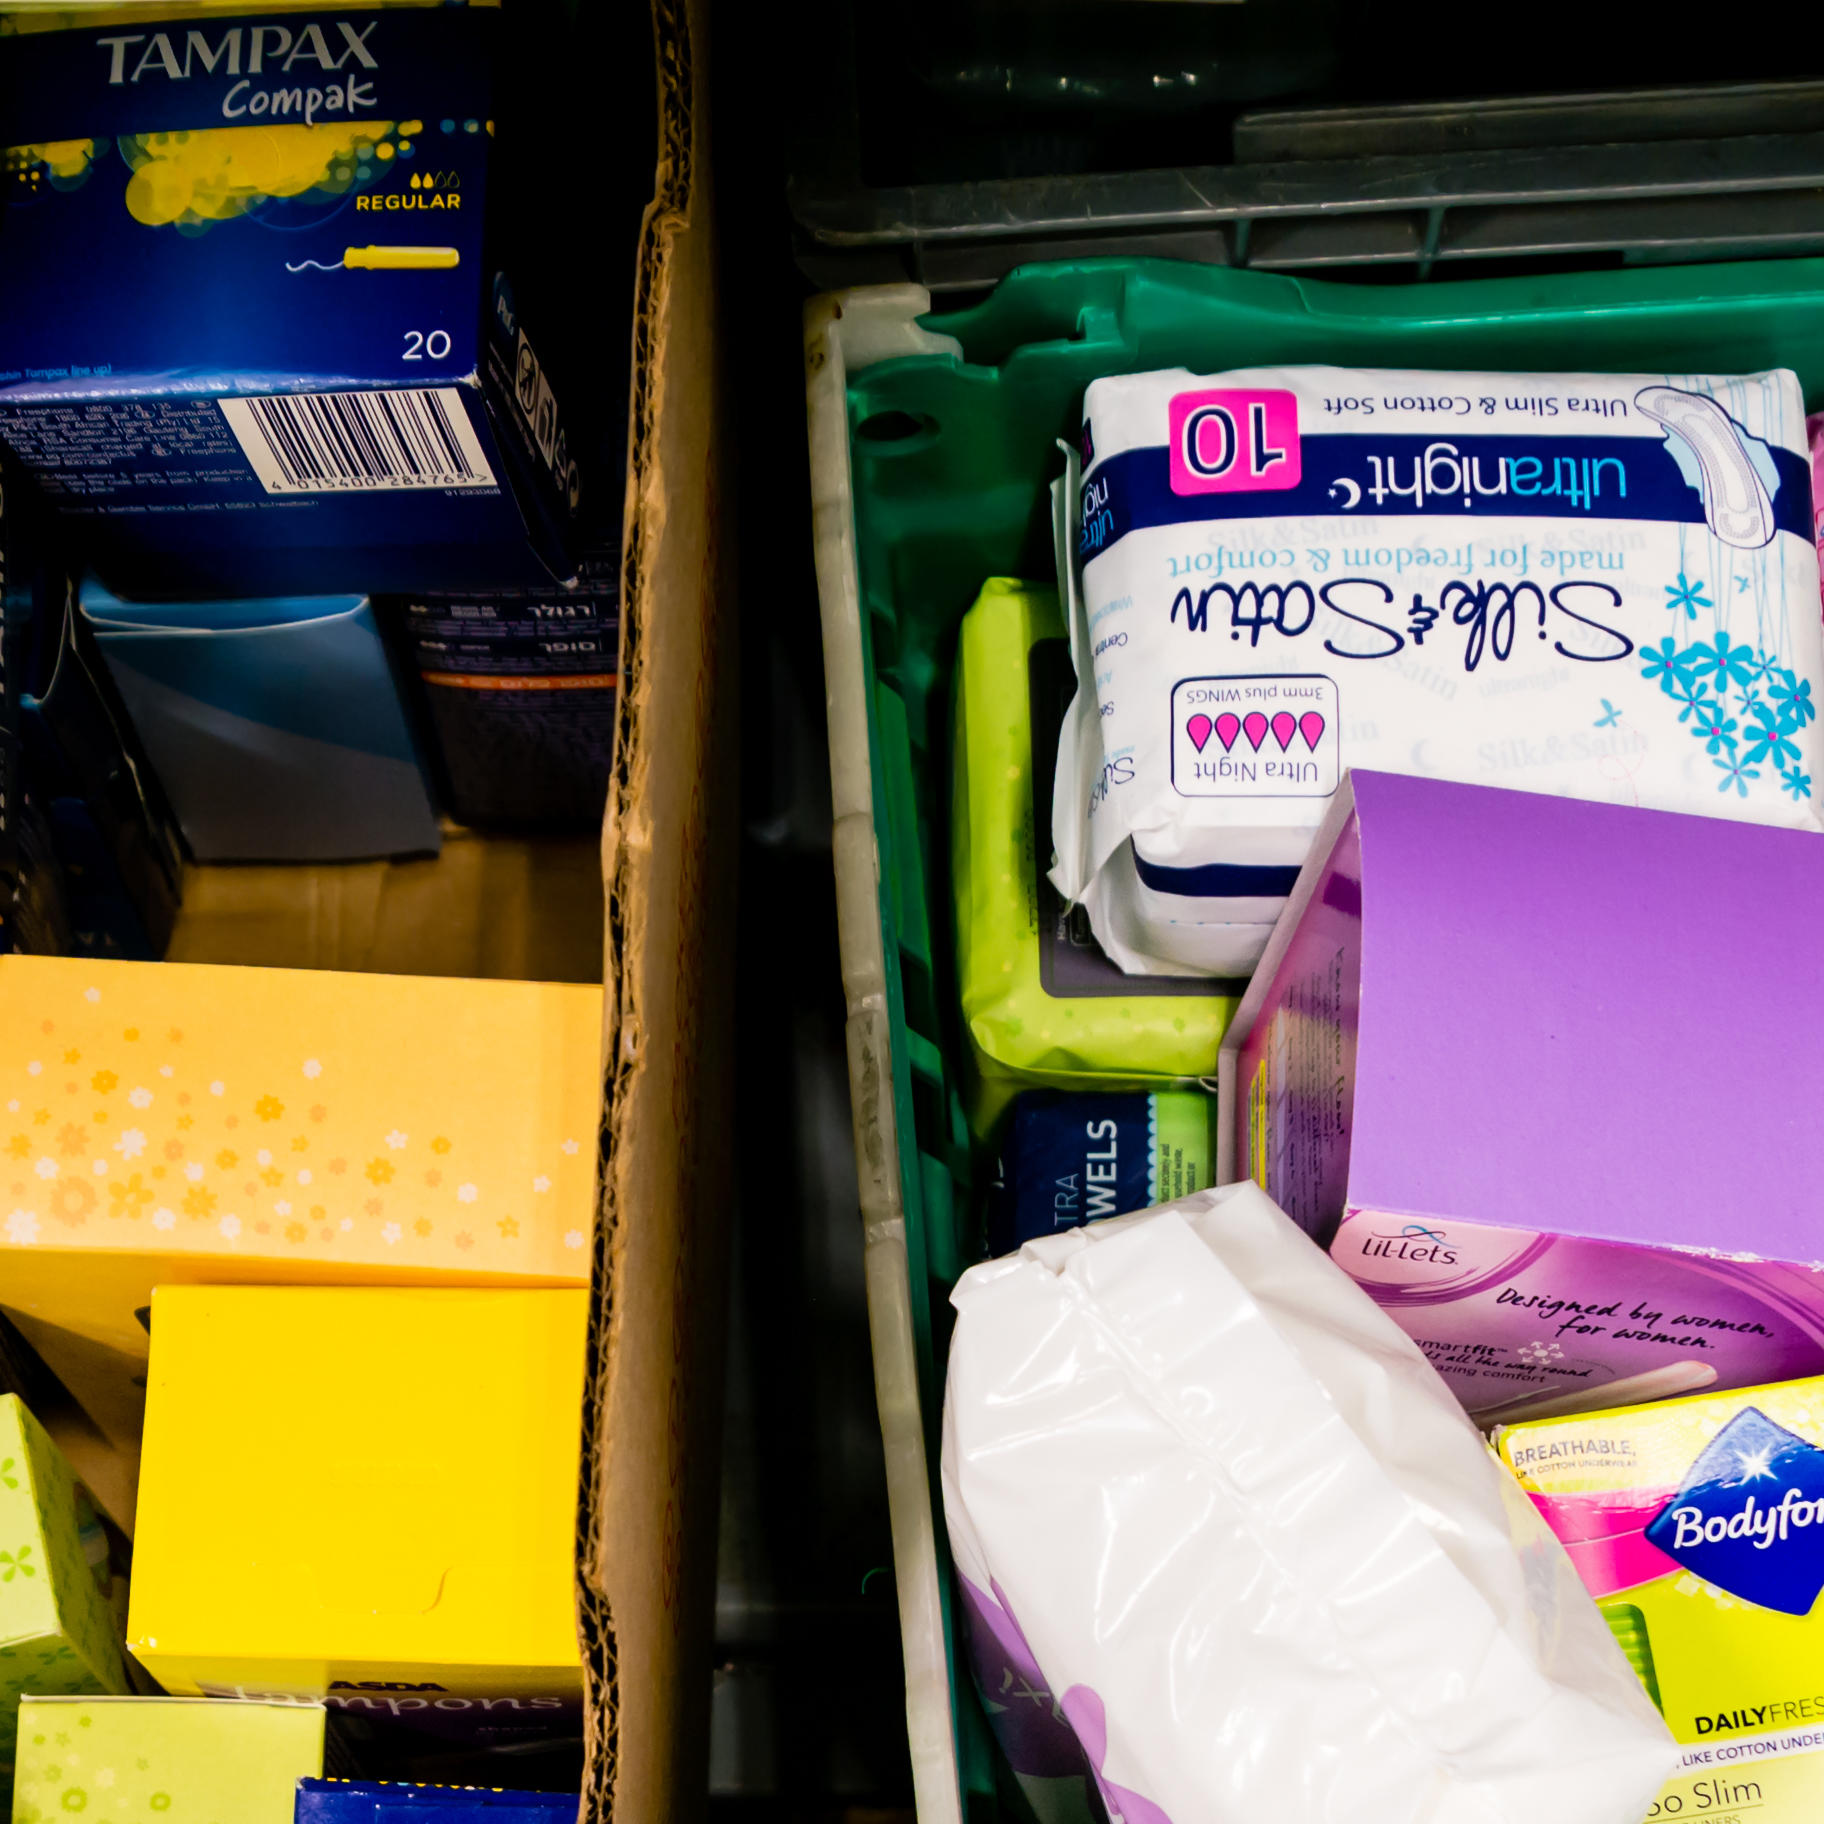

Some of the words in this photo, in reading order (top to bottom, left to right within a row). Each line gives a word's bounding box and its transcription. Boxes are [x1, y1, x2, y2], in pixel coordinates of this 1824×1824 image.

[97, 21, 379, 85] TAMPAX
[222, 75, 377, 125] Compak
[356, 194, 460, 211] REGULAR
[402, 329, 451, 361] 20
[1323, 396, 1376, 417] Soft
[1382, 397, 1471, 419] Cotton
[1478, 398, 1497, 418] &
[1505, 397, 1558, 418] Slim
[1568, 397, 1628, 418] Ultra
[1185, 401, 1288, 477] 10
[1366, 441, 1626, 510] ultranight
[1167, 543, 1296, 581] comfort
[1306, 548, 1331, 573] &
[1343, 542, 1475, 575] freedom
[1483, 542, 1529, 575] for
[1540, 548, 1625, 576] made
[1186, 687, 1242, 704] WINGS
[1244, 685, 1277, 702] plus
[1283, 687, 1324, 702] 3mm
[1193, 757, 1257, 782] Night
[1265, 761, 1318, 781] Ultra
[1086, 1119, 1118, 1224] WELS
[1054, 1172, 1080, 1226] TRA
[1496, 1287, 1624, 1320] Designed
[1629, 1303, 1665, 1328] by
[1674, 1314, 1776, 1339] women,
[1555, 1316, 1604, 1339] for
[1611, 1326, 1715, 1350] women.
[1682, 1750, 1713, 1767] LIKE
[1716, 1741, 1778, 1761] COTTON
[1692, 1778, 1763, 1809] Slim
